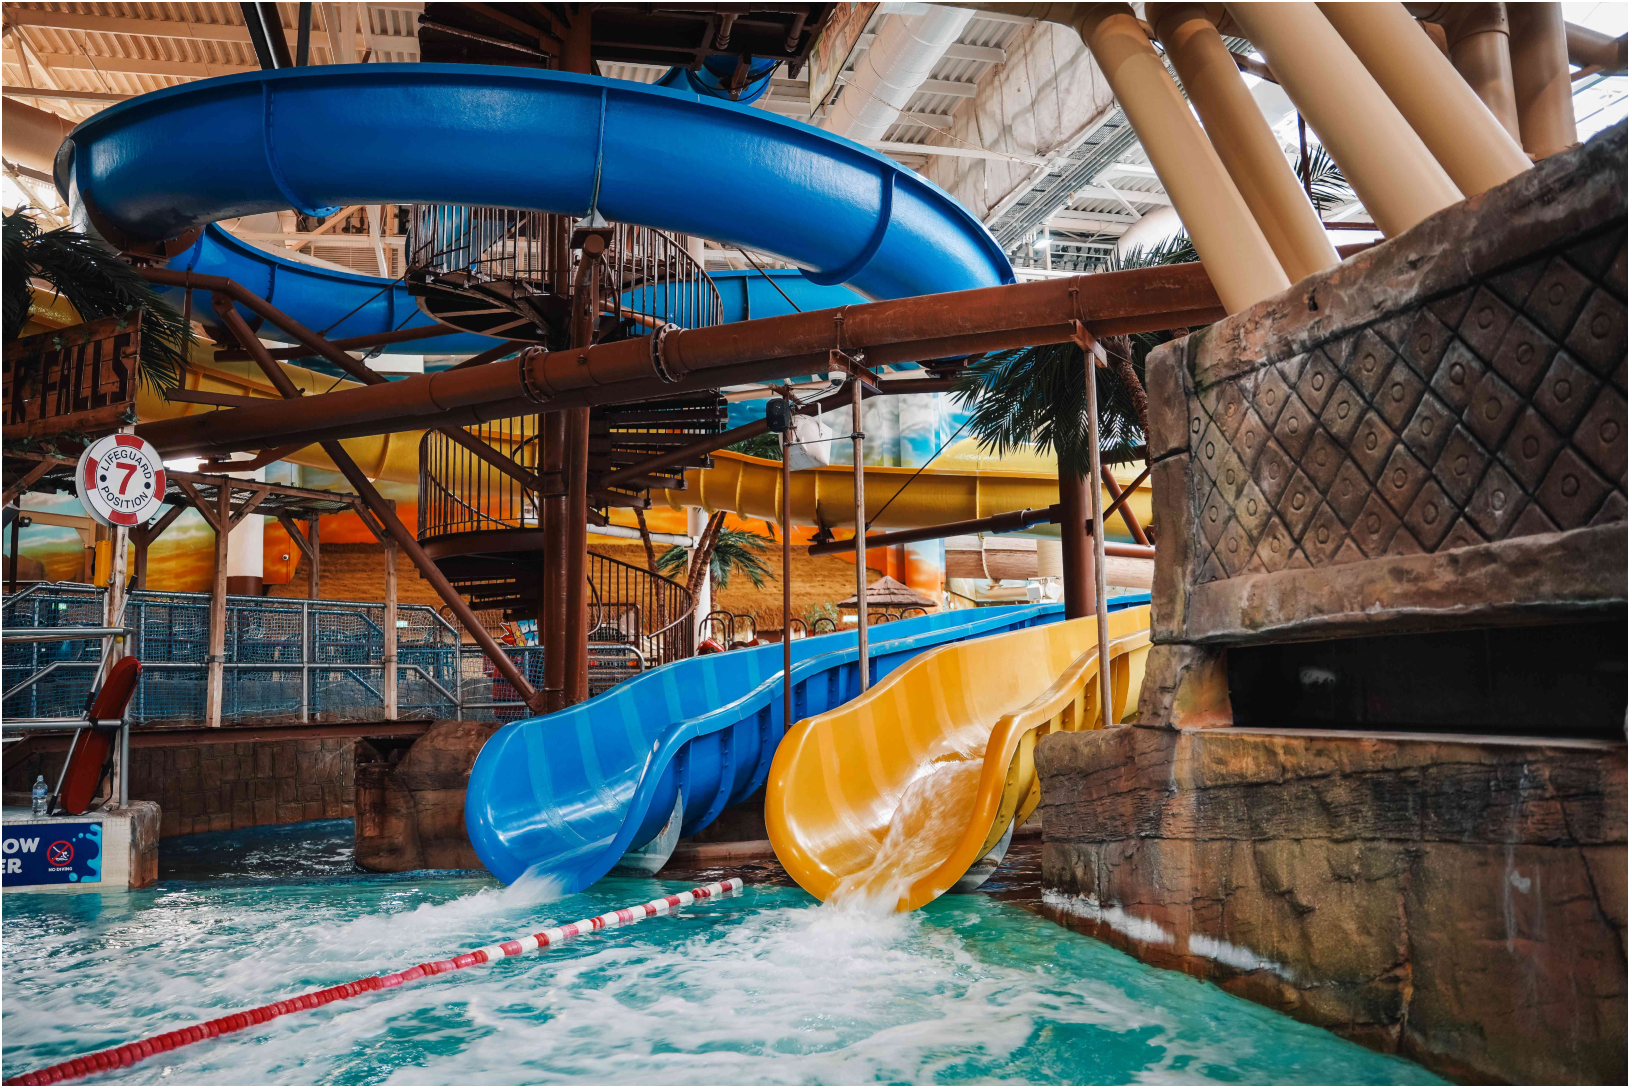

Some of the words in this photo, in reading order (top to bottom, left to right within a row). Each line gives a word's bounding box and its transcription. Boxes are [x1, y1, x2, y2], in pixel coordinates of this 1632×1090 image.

[39, 333, 132, 420] FALLS
[100, 449, 152, 480] LIFEGUARD
[115, 461, 138, 496] 7
[100, 485, 149, 509] POSITION
[2, 837, 41, 854] OW
